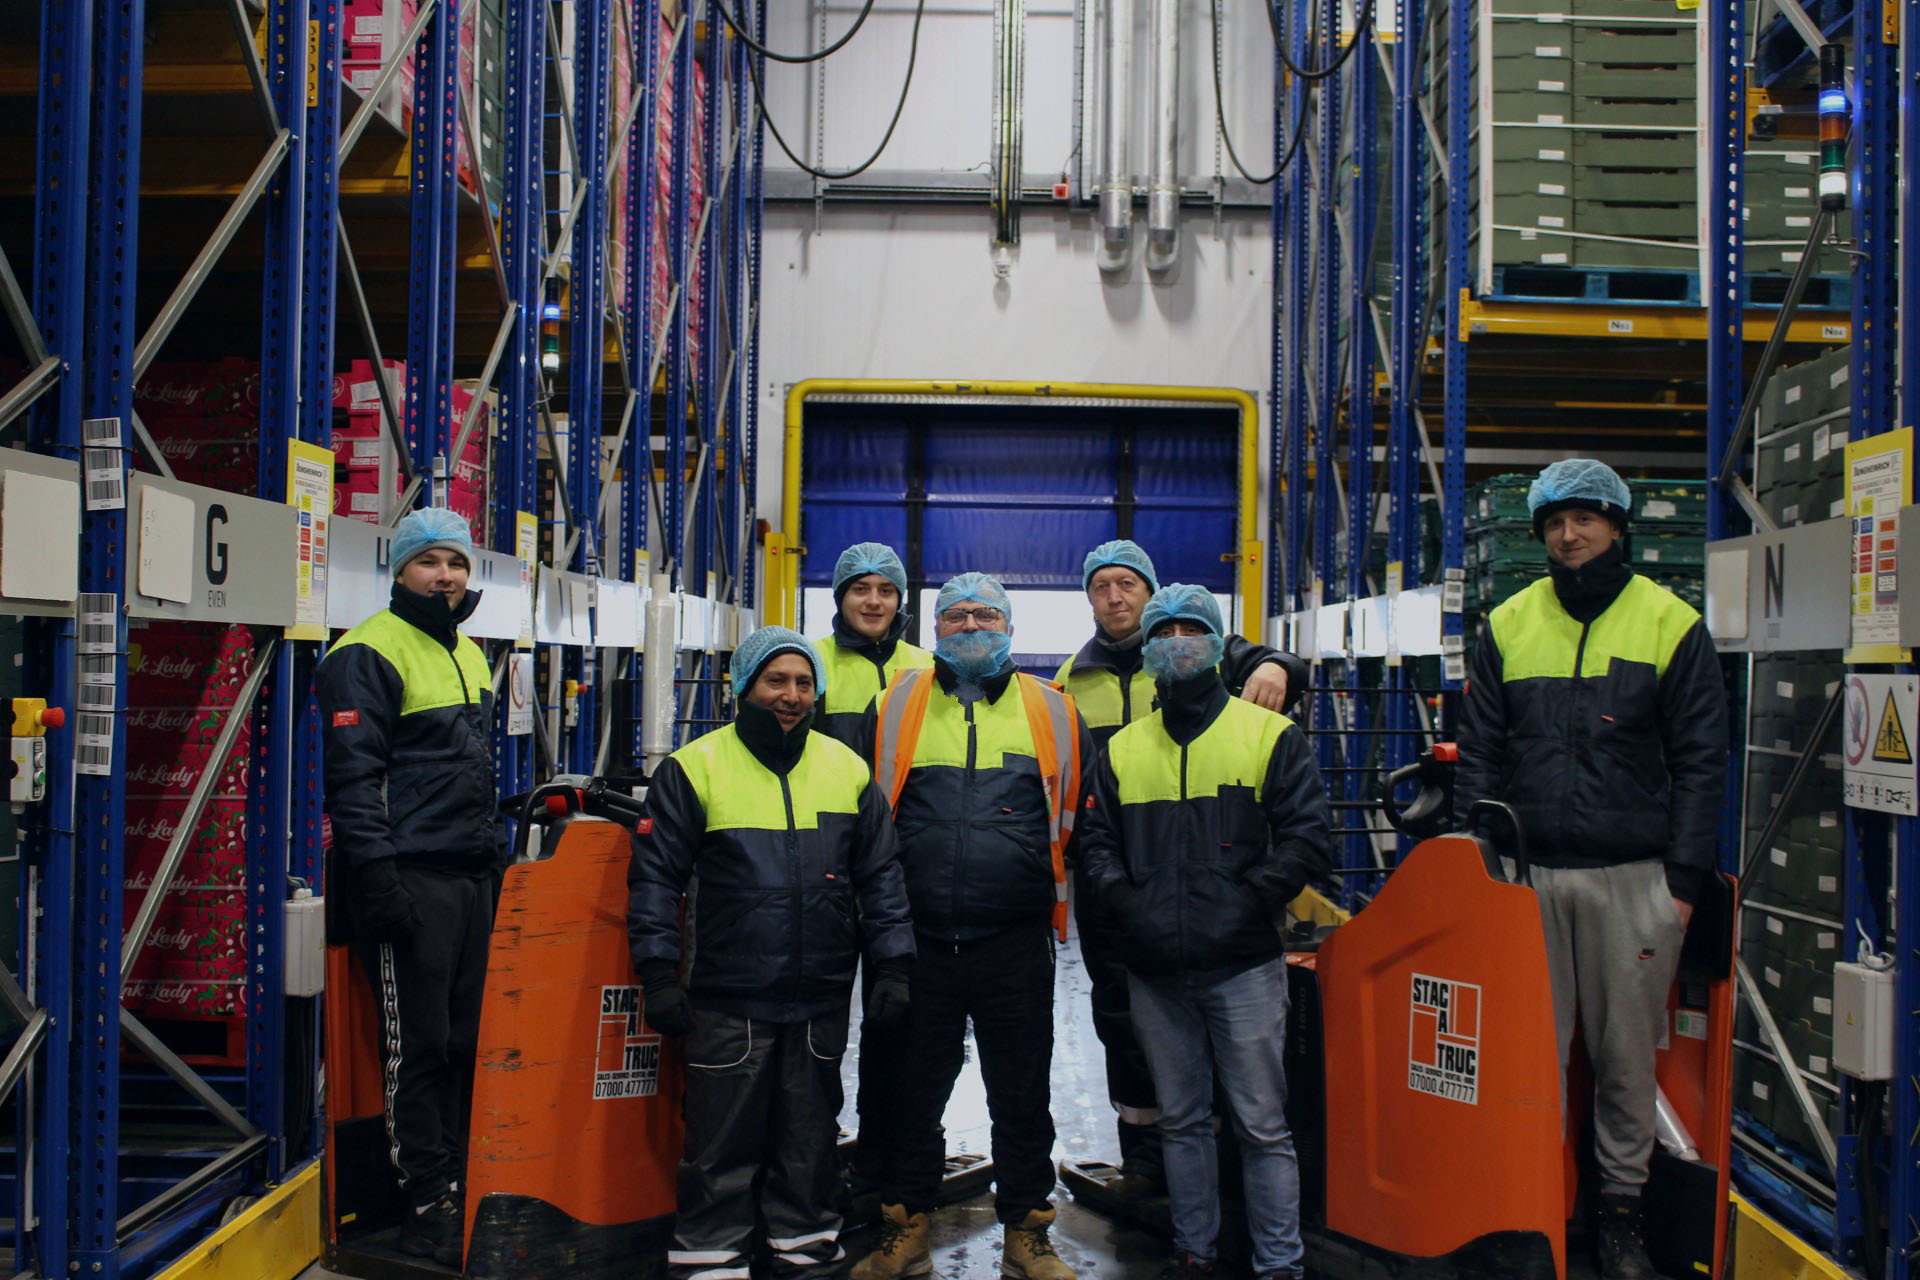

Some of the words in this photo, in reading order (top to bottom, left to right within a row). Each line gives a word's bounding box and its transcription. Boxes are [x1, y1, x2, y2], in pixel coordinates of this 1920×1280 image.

[206, 503, 229, 585] G
[1764, 543, 1784, 619] N
[208, 589, 226, 608] EVEN
[149, 655, 196, 680] Lady
[147, 706, 195, 734] Lady
[147, 764, 194, 788] Lady
[146, 926, 193, 951] Lady
[146, 980, 193, 1005] Lady
[603, 988, 639, 1013] STAC
[1412, 977, 1449, 1009] STAC
[627, 1013, 637, 1036] A
[1438, 1009, 1448, 1033] A
[625, 1044, 659, 1070] TRUC
[1437, 1042, 1476, 1076] TRUC
[595, 1081, 623, 1097] 07000
[624, 1079, 657, 1096] 477777
[1409, 1072, 1437, 1093] 07000
[1438, 1080, 1475, 1103] 477777
